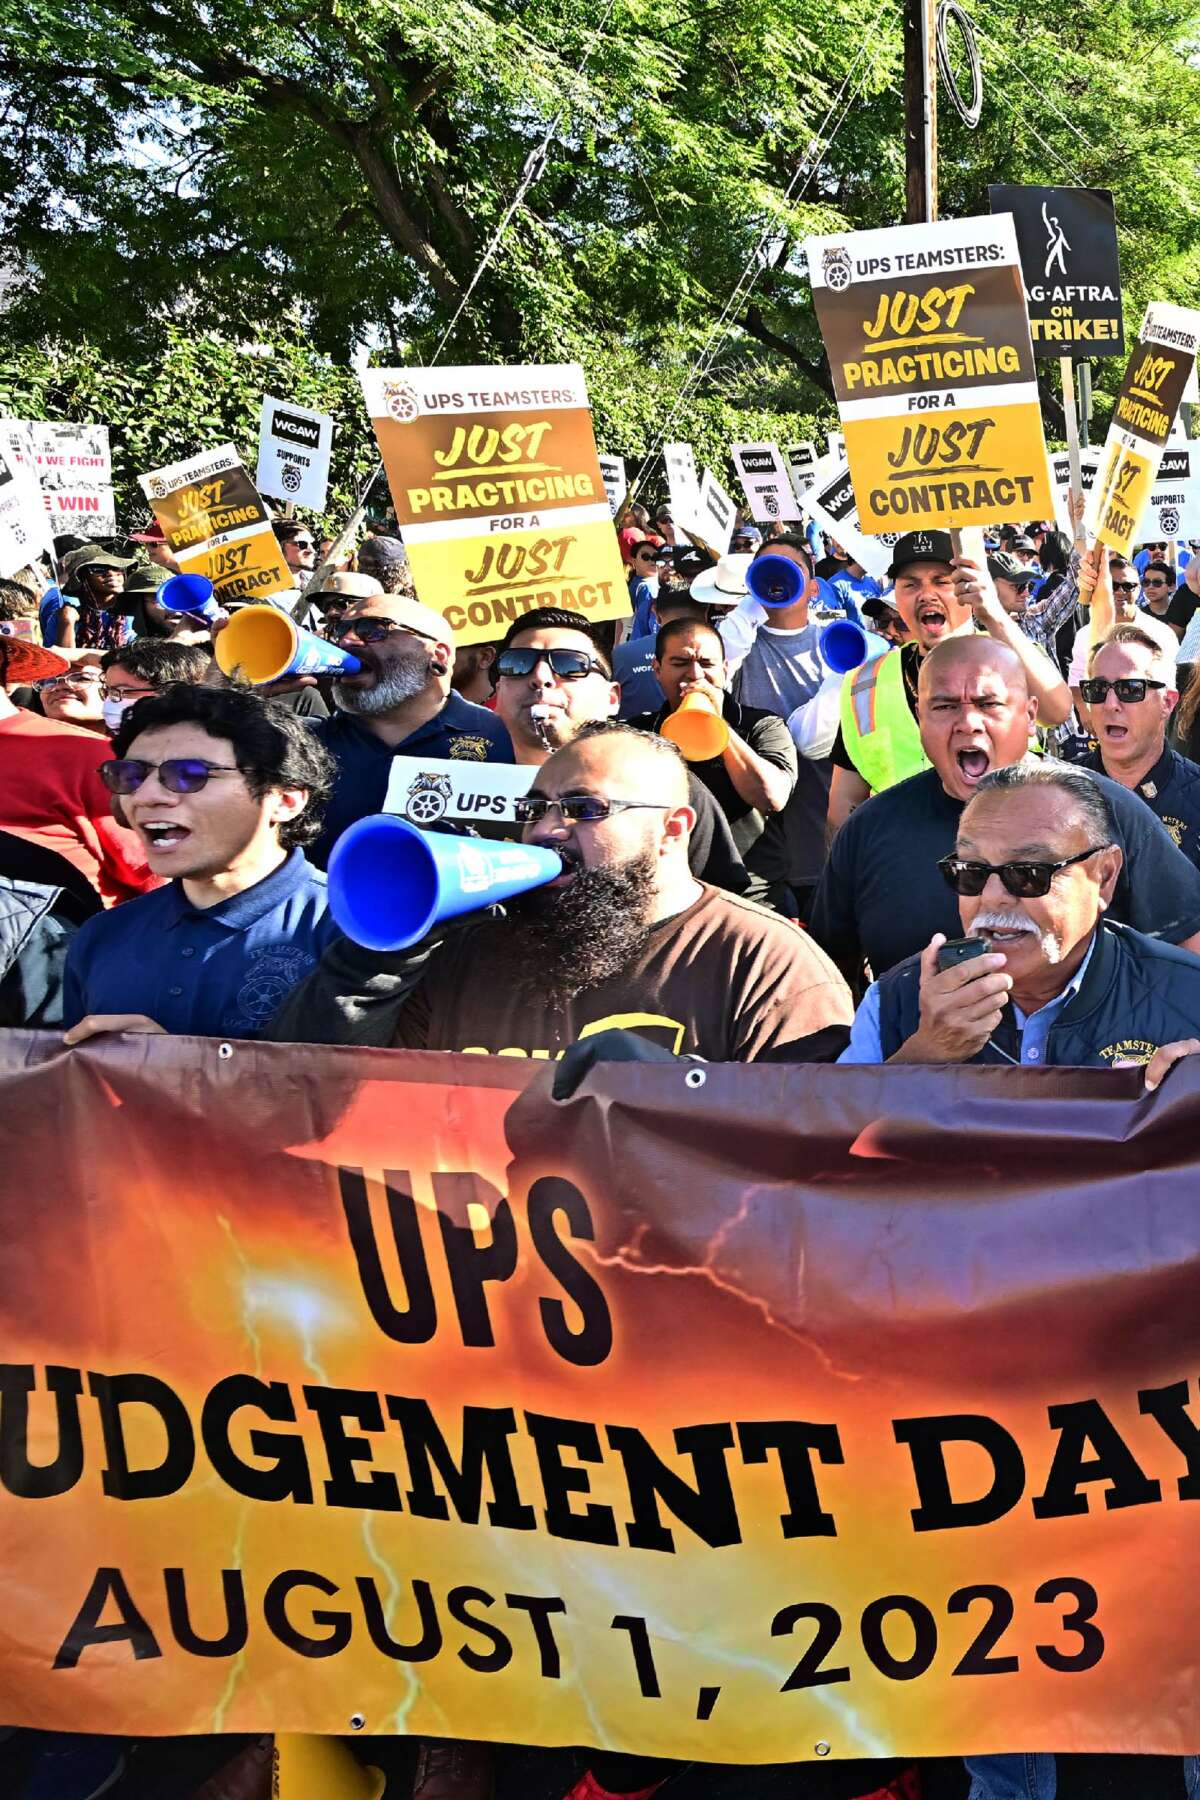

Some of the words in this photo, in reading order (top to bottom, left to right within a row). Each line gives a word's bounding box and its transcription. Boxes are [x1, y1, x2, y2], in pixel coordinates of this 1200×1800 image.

[856, 257, 890, 276] UPS
[895, 244, 1005, 272] TEAMSTERS:
[864, 284, 976, 338] JUST
[1051, 306, 1073, 317] ON
[1030, 319, 1119, 340] TRIKE!
[843, 346, 1020, 389] PRACTICING
[424, 393, 464, 410] UPS
[468, 390, 577, 408] TEAMSTERS:
[908, 395, 939, 410] FOR
[943, 393, 956, 407] A
[275, 418, 318, 440] WGAW
[434, 422, 552, 466] JUST
[888, 418, 996, 466] JUST
[46, 456, 65, 465] WE
[70, 457, 105, 467] FIGHT
[167, 476, 183, 488] UPS
[183, 458, 234, 481] TEAMSTERS:
[277, 449, 311, 467] SUPPORTS
[742, 457, 772, 468] WGAW
[1158, 457, 1188, 471] GAW
[58, 496, 99, 511] WIN
[178, 480, 225, 518] JUST
[407, 474, 594, 514] PRACTICING
[869, 477, 1034, 517] CONTRACT
[1151, 494, 1186, 506] SUPPORTS
[171, 506, 259, 546] PRACTICING
[222, 535, 229, 543] A
[489, 517, 525, 532] FOR
[530, 516, 540, 527] A
[204, 544, 251, 579] JUST
[464, 536, 578, 584] JUST
[214, 566, 281, 602] ONTRACT
[457, 793, 507, 814] UPS
[338, 1166, 612, 1367] UPS
[0, 1363, 845, 1555] UDGEMENT
[52, 1567, 566, 1679] AUGUST
[771, 1577, 1105, 1692] 2023
